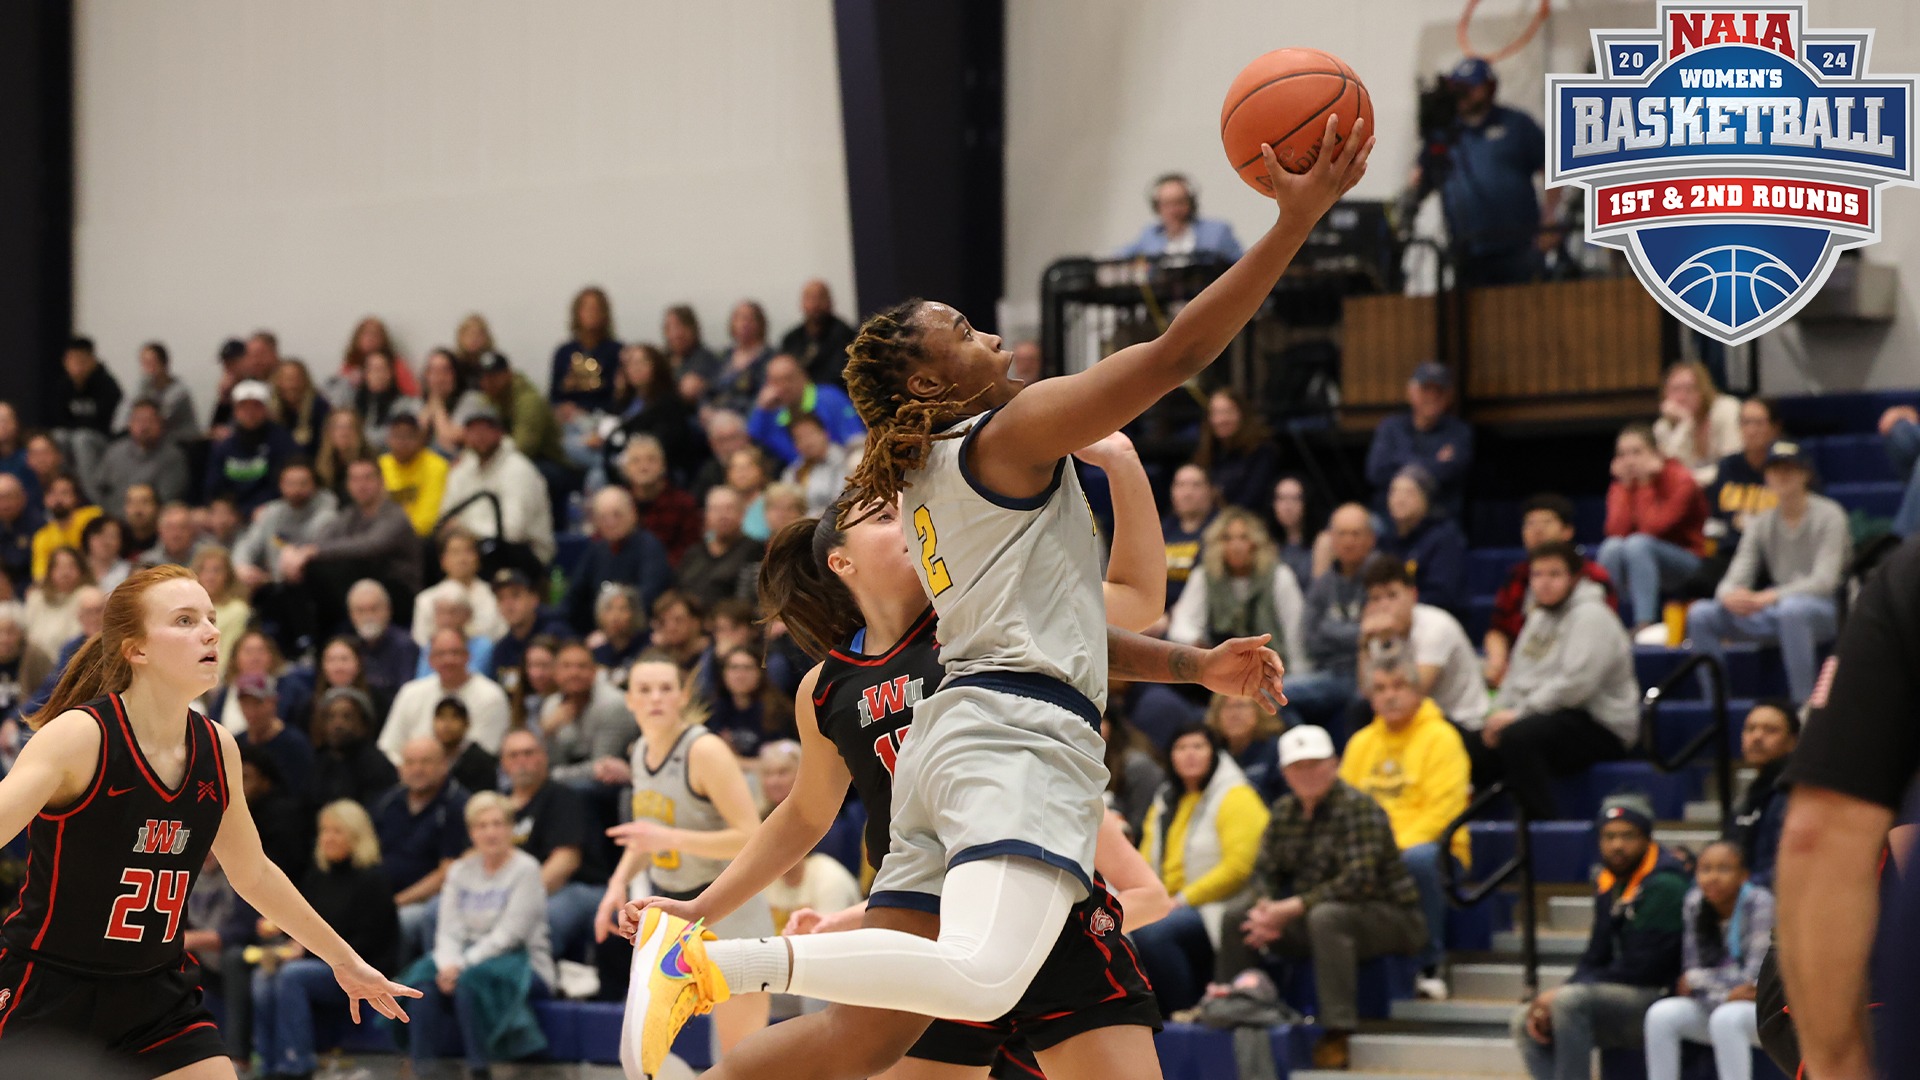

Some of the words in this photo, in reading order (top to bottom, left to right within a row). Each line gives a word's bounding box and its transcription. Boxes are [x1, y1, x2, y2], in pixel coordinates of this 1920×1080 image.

[913, 503, 954, 599] 2
[857, 674, 924, 728] IWU
[132, 819, 191, 855] IWU
[103, 867, 190, 943] 24
